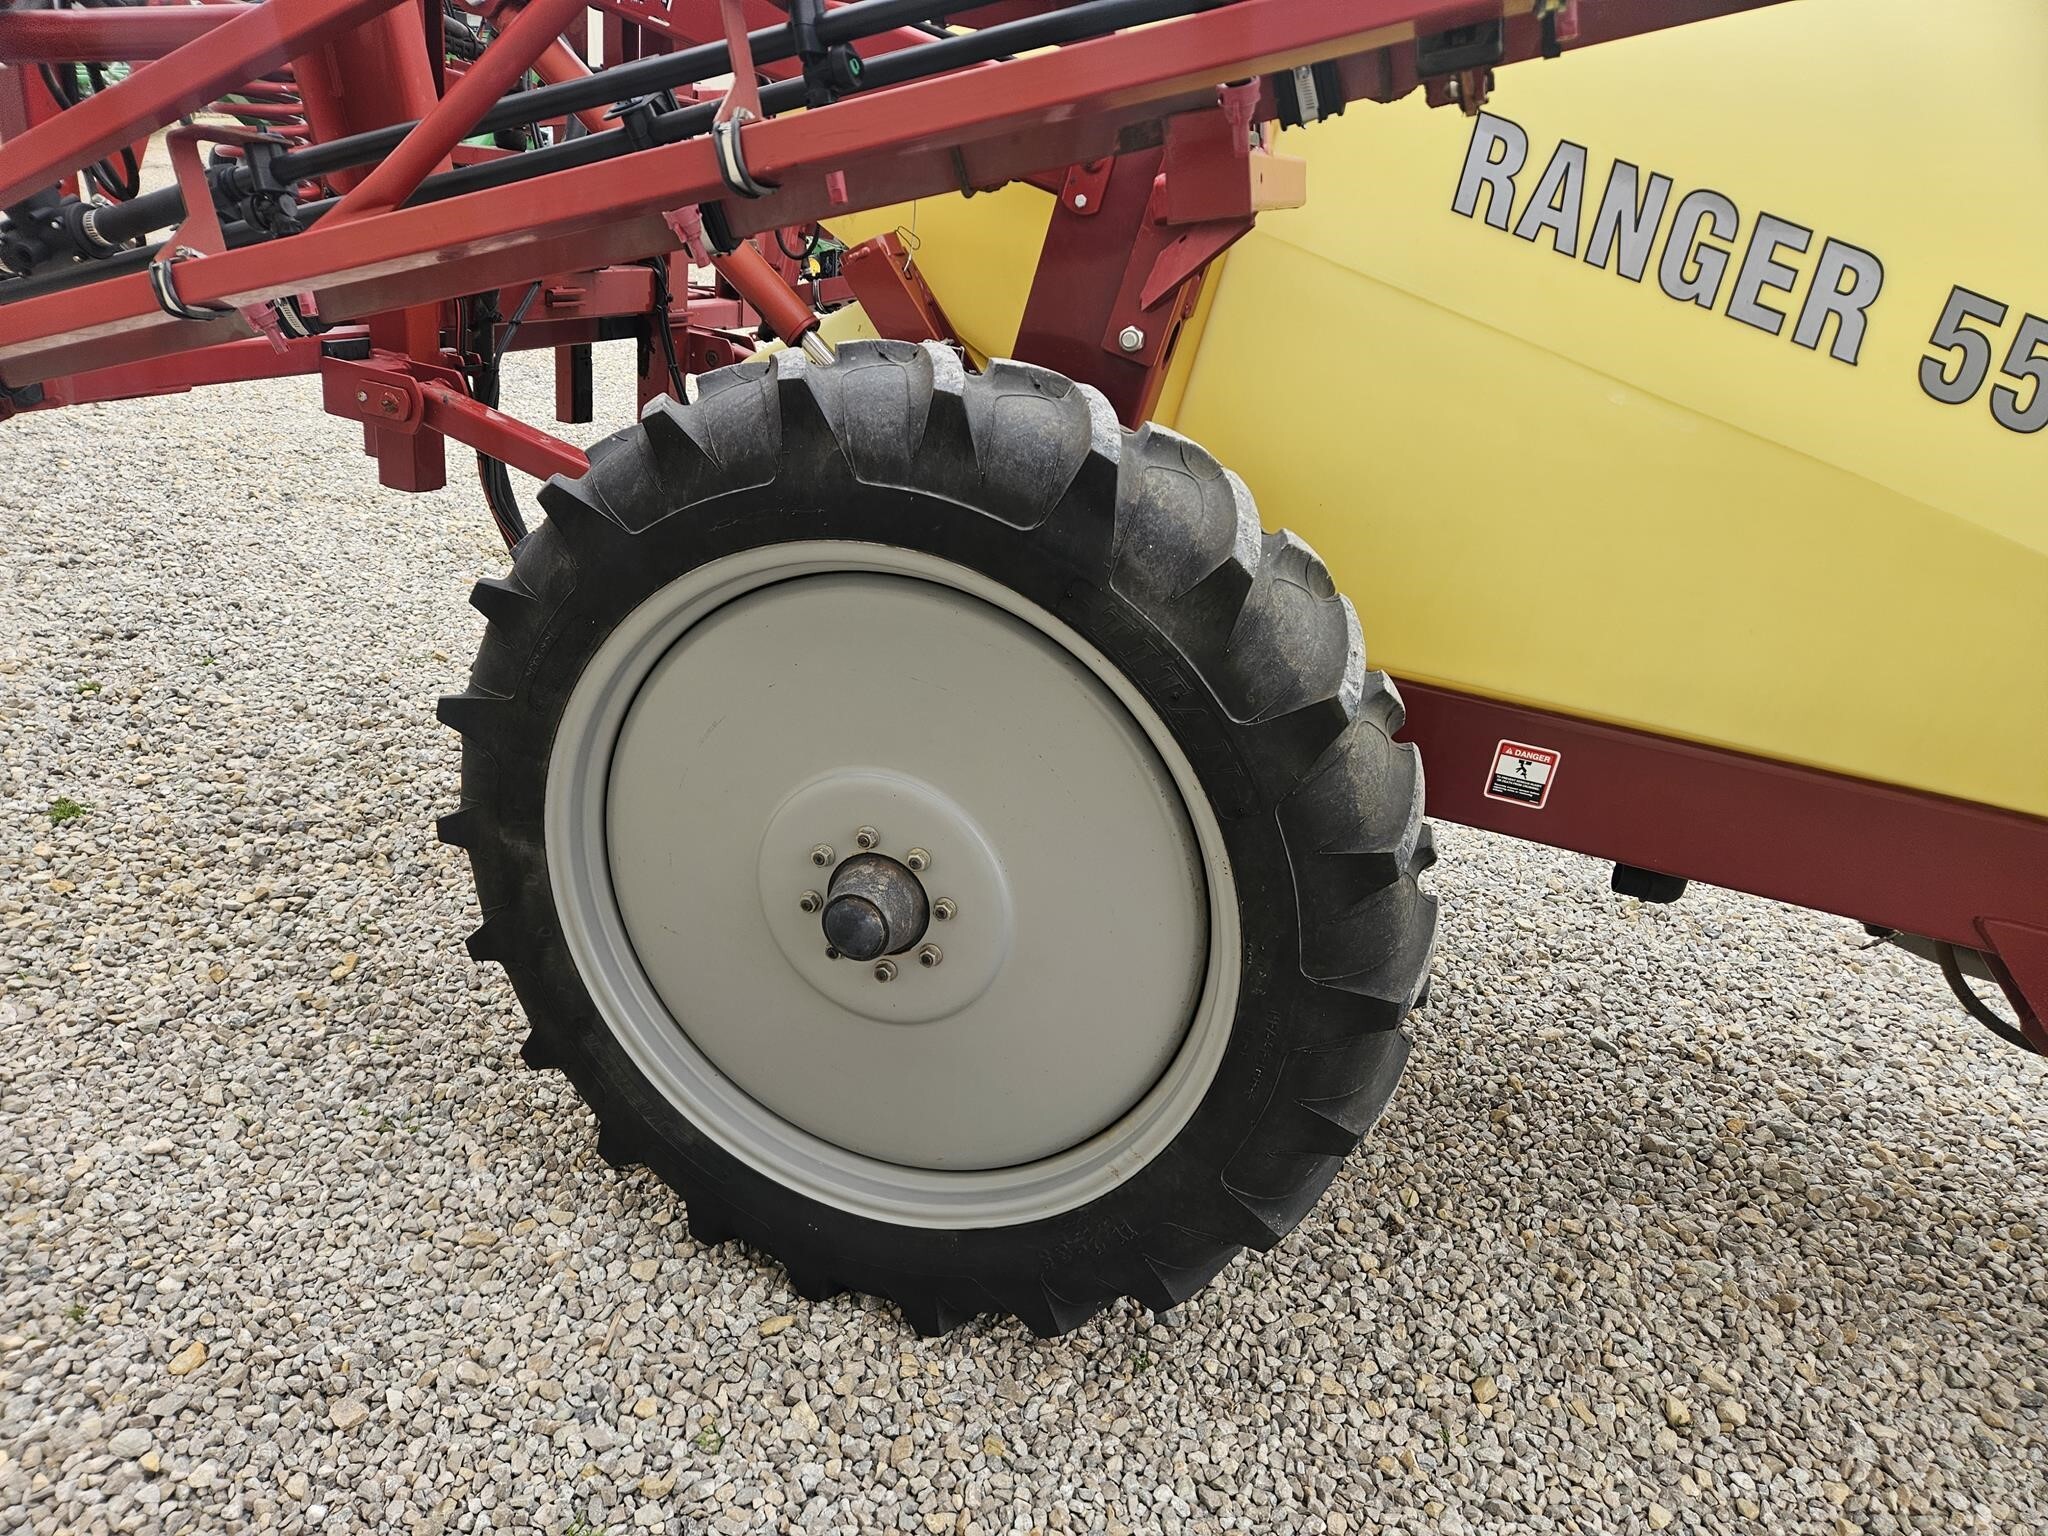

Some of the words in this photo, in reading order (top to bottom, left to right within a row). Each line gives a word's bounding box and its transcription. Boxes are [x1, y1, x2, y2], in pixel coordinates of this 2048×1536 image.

[1451, 110, 1885, 366] RANGER
[1918, 285, 2048, 434] 55
[1514, 749, 1551, 763] DANGER
